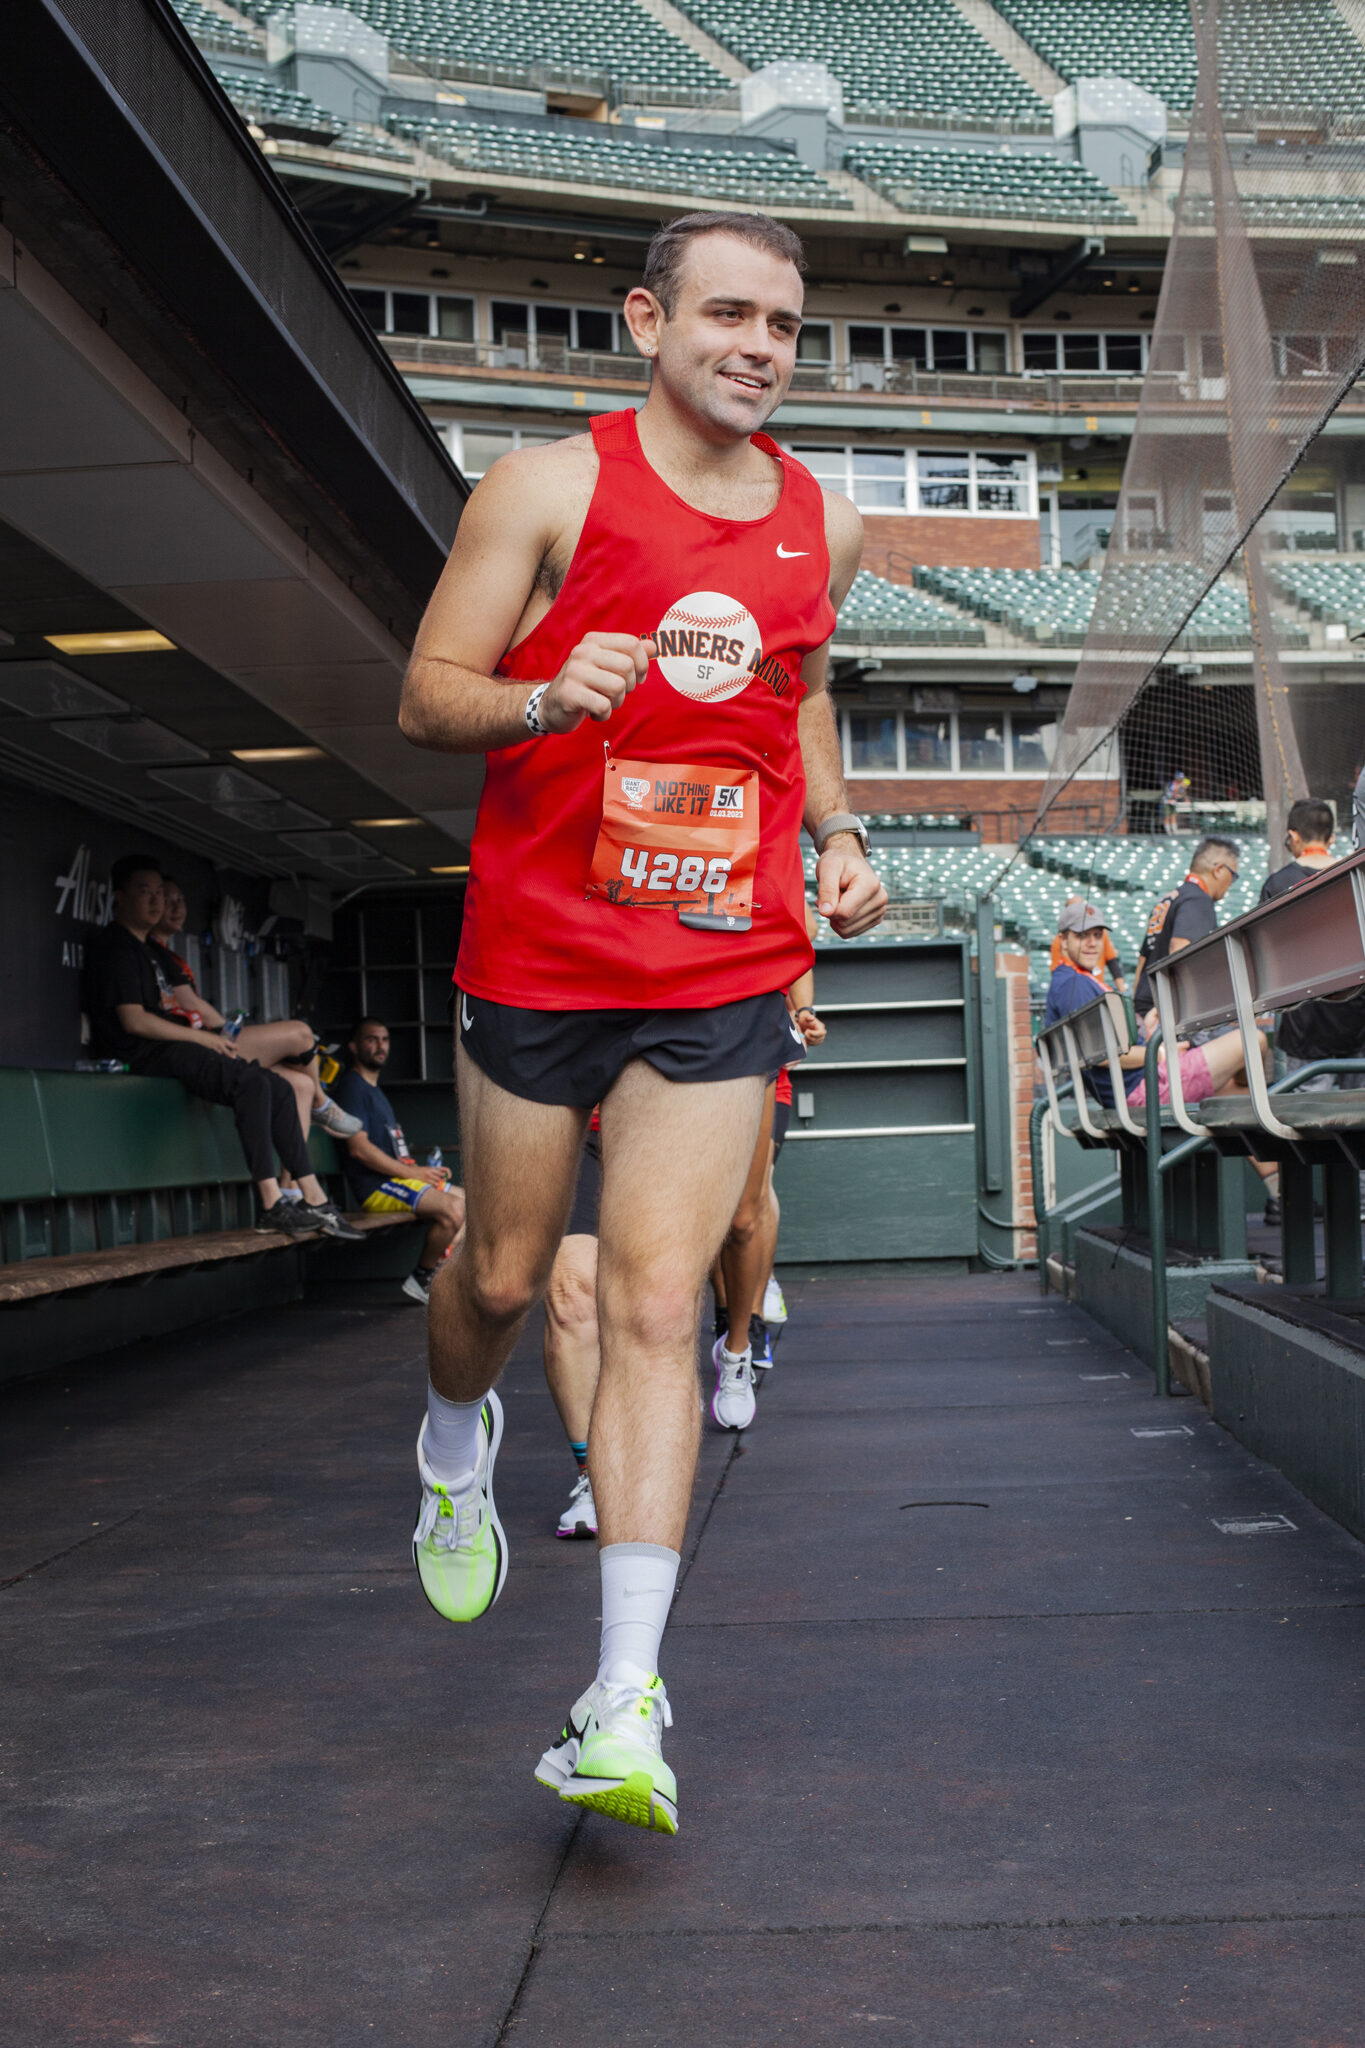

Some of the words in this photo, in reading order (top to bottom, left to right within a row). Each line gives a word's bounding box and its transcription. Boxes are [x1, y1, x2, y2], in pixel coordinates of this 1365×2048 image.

[640, 629, 744, 666] UNNERS
[747, 647, 790, 697] MIND
[696, 664, 714, 680] SF
[655, 780, 710, 795] NOTHING
[653, 797, 686, 814] LIKE
[690, 797, 708, 815] IT
[717, 788, 738, 807] 5K
[620, 847, 732, 893] 4286
[54, 843, 116, 927] Alask
